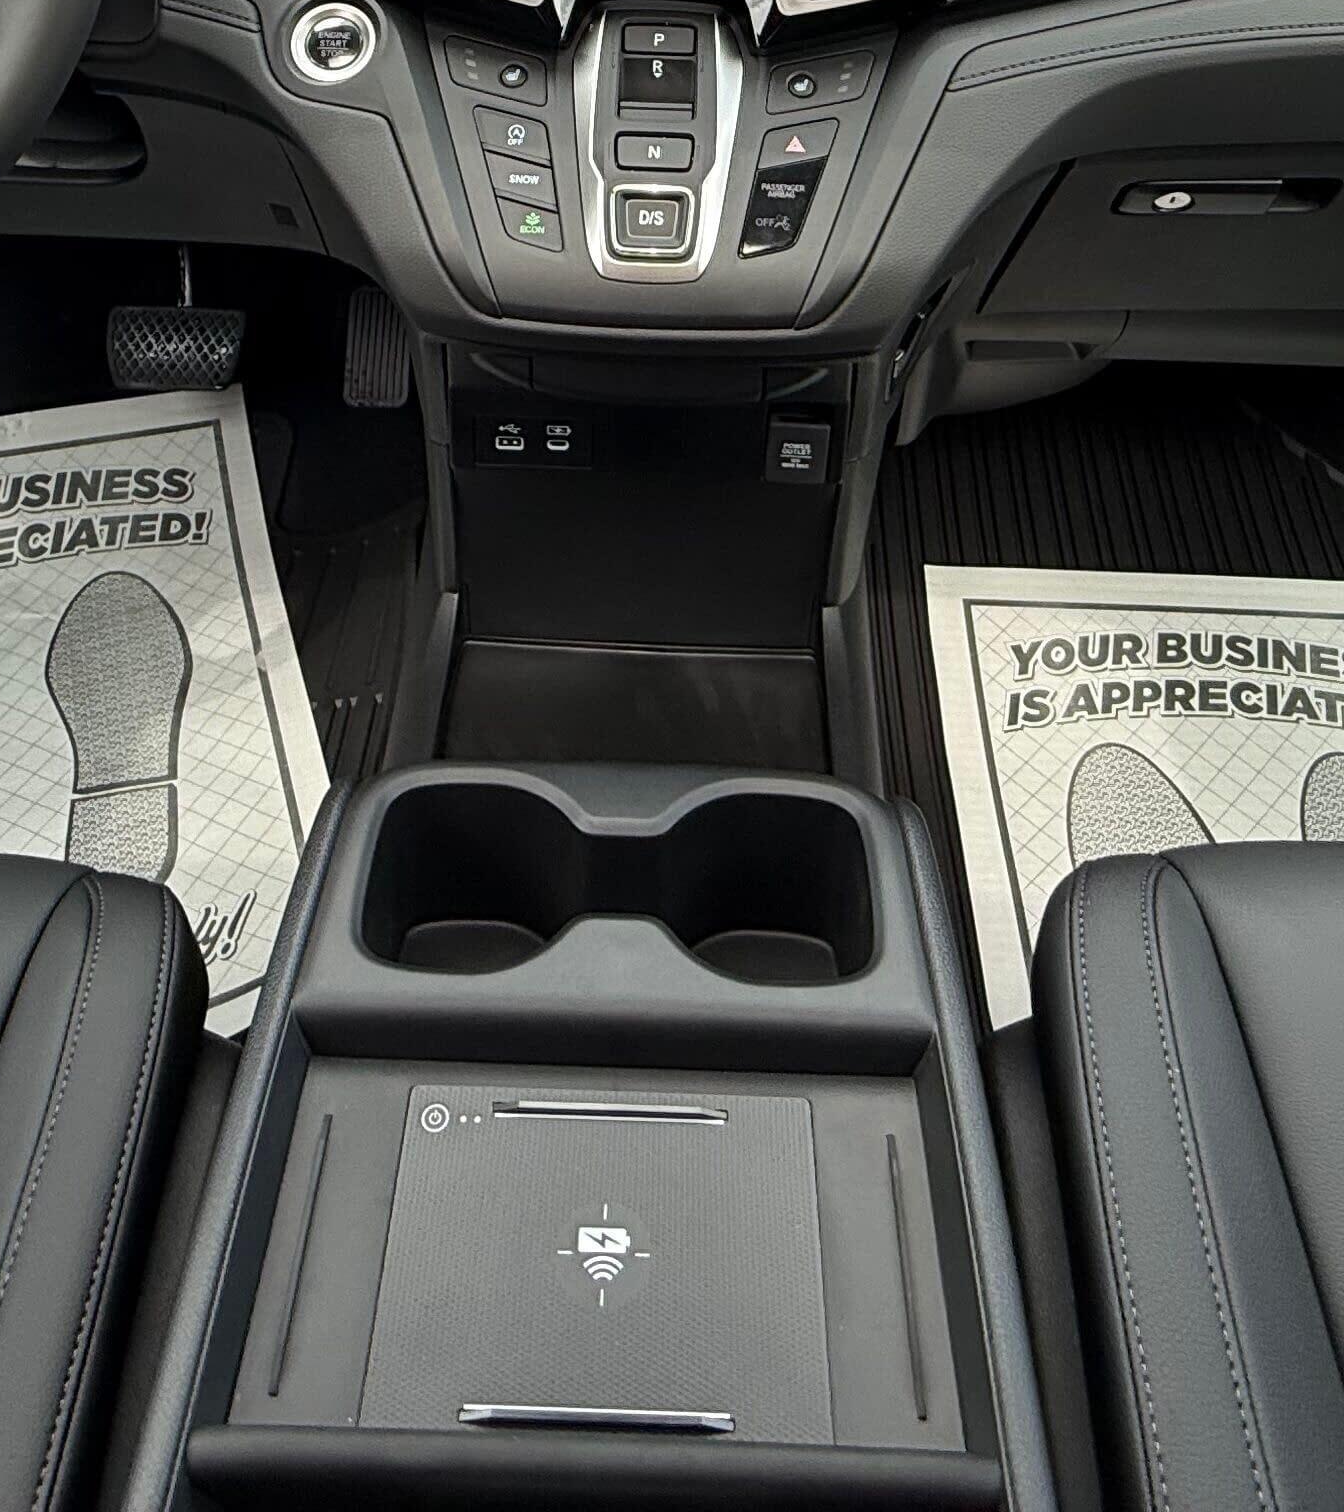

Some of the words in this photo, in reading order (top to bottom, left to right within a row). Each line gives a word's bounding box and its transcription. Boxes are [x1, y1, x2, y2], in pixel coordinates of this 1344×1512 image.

[318, 31, 352, 39] ENGINE
[653, 33, 664, 47] P
[320, 39, 348, 47] START
[652, 60, 663, 73] R
[647, 145, 661, 159] N
[509, 174, 540, 185] SNOW
[638, 209, 664, 226] D/S
[755, 217, 775, 227] OFF
[519, 225, 545, 234] ECON
[1007, 632, 1149, 680] YOUR
[1004, 687, 1056, 731] IS
